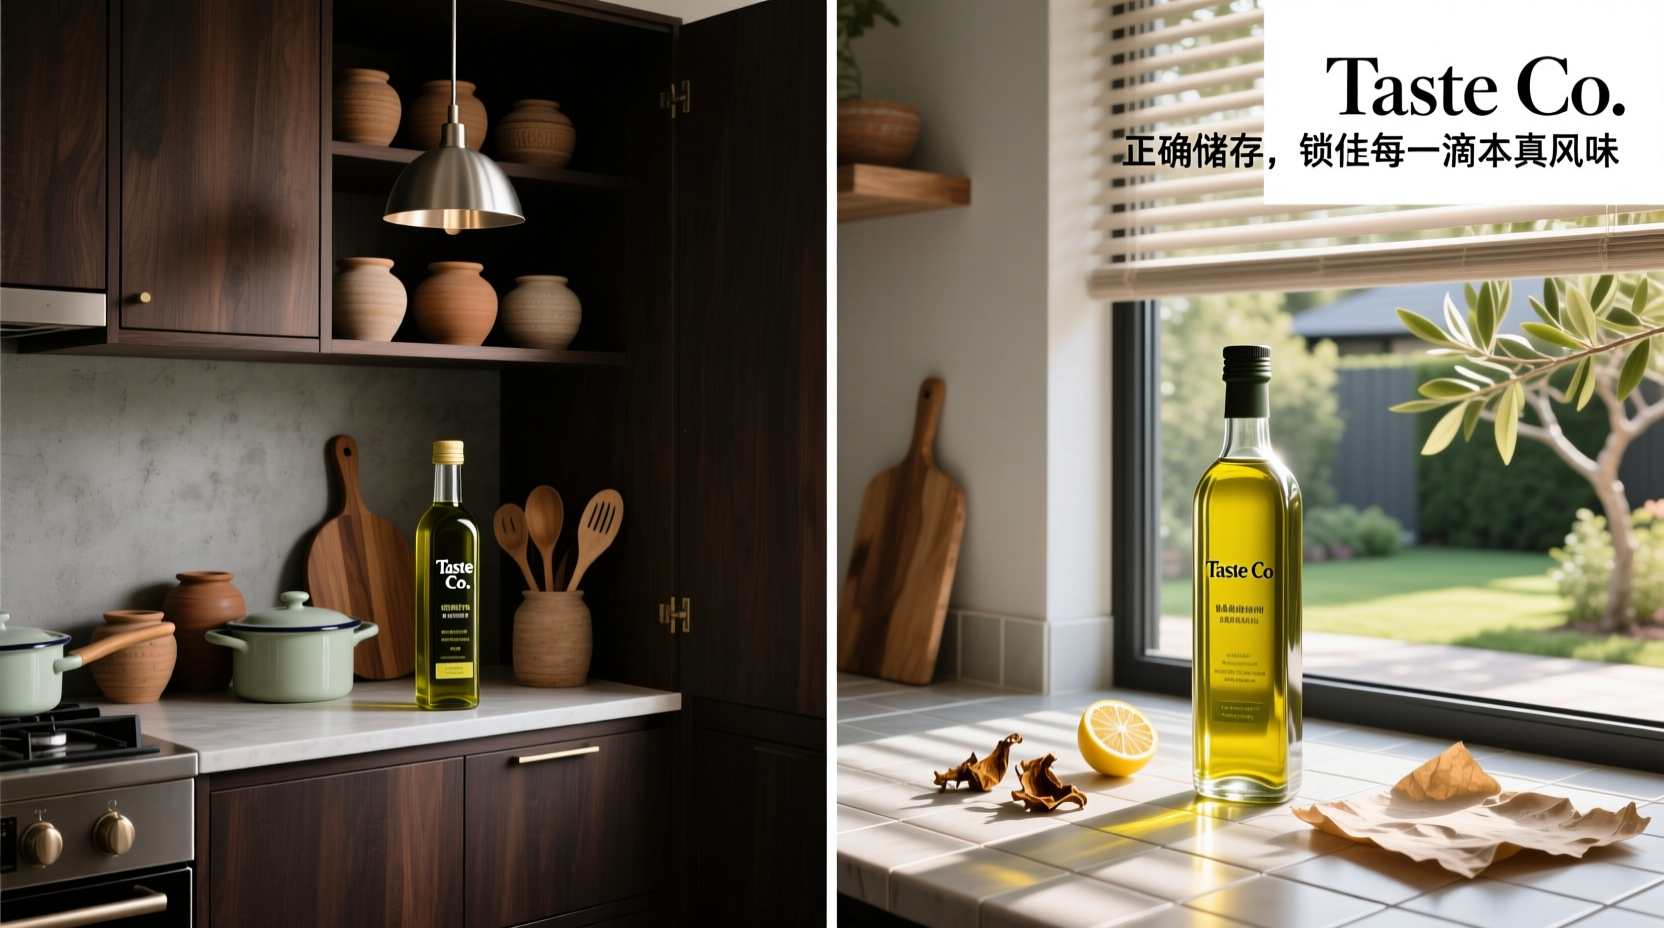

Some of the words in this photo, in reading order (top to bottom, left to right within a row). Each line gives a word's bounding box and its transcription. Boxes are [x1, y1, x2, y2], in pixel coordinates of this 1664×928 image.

[436, 559, 474, 575] Taste
[1206, 560, 1248, 579] Taste
[1251, 561, 1274, 579] Co
[445, 575, 471, 589] Co.
